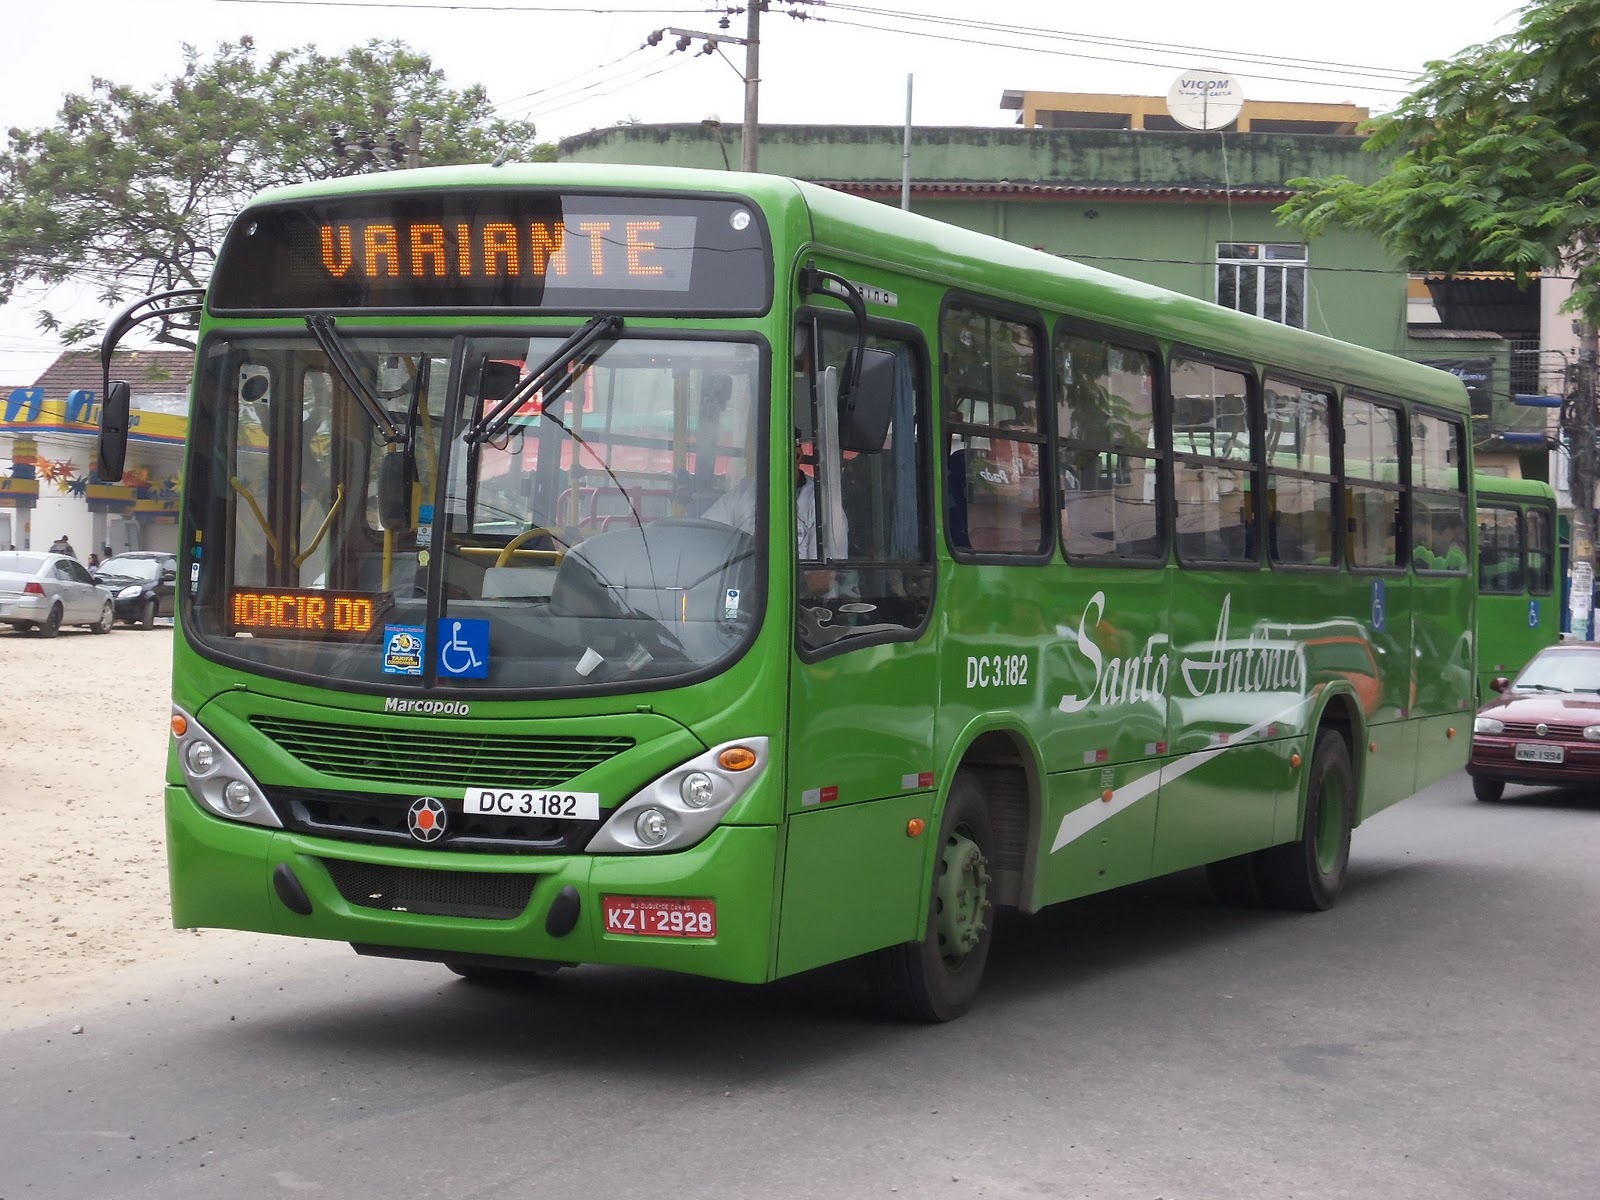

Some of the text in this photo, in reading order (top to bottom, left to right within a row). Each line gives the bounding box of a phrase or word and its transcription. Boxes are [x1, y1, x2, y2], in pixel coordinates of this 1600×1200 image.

[1181, 79, 1229, 89] VICOM
[320, 221, 664, 278] VARIANTE
[234, 593, 372, 632] OACIR DO
[1058, 590, 1169, 713] Santo
[966, 654, 1028, 689] DC 3.182
[384, 697, 470, 716] Marcopolo
[479, 791, 577, 816] DC 3.182
